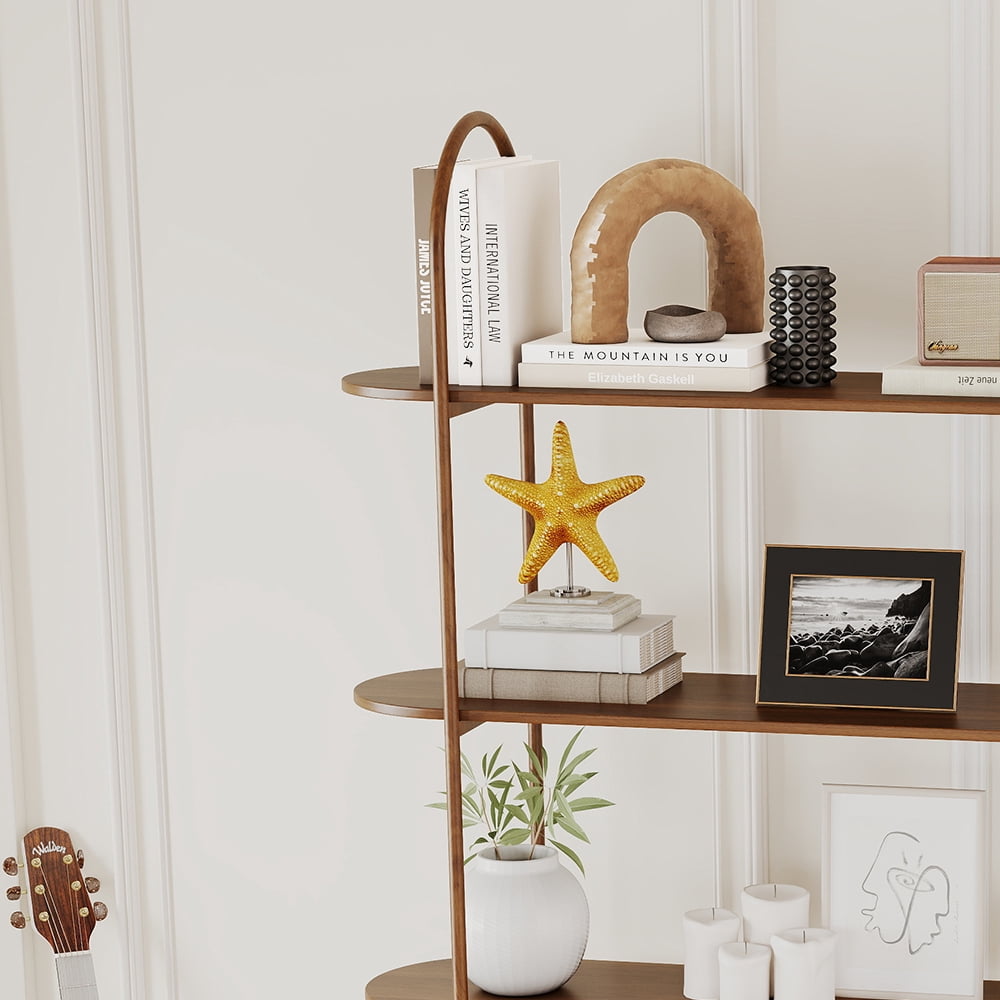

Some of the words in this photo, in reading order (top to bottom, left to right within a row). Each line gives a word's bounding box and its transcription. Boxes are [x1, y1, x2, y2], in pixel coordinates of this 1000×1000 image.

[459, 188, 470, 232] WIVES
[418, 239, 430, 276] JAMES
[460, 235, 472, 264] AND
[486, 223, 500, 316] INTERNATIONAL
[462, 268, 475, 349] DAUGHTERS
[488, 319, 501, 343] LAW
[549, 350, 575, 360] THE
[584, 351, 668, 362] MOUNTAIN
[675, 353, 689, 362] IS
[696, 353, 728, 363] YOU
[588, 371, 645, 384] Elizabeth
[648, 374, 695, 385] Gaskell
[958, 376, 975, 385] Zeit
[976, 376, 998, 384] neue
[32, 841, 66, 856] Walden
